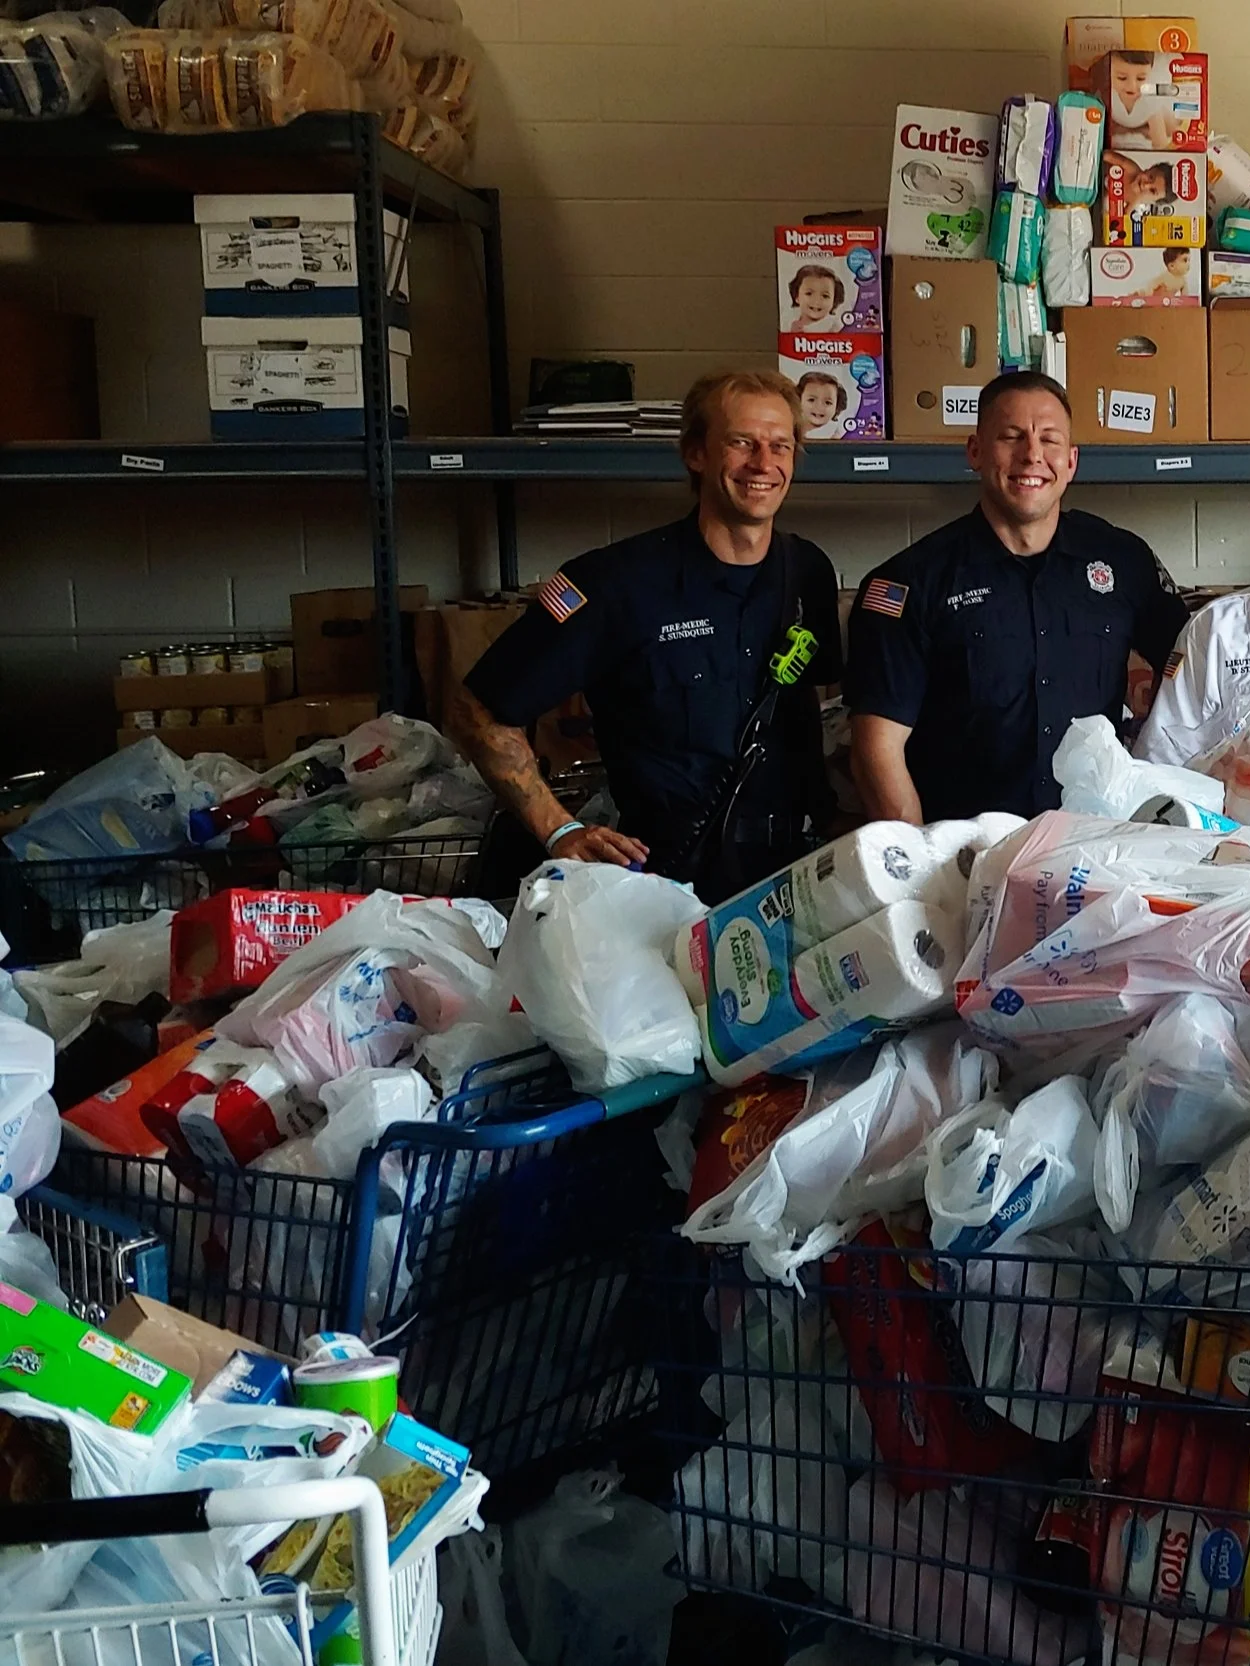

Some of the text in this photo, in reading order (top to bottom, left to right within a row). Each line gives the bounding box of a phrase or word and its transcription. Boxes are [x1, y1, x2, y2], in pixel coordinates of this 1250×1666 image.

[1169, 32, 1180, 50] 3
[900, 123, 990, 158] Cuties
[785, 230, 844, 246] HUGGIES
[794, 337, 853, 353] HUGGIES
[805, 357, 843, 365] movers
[264, 369, 300, 379] SPAGHETTI
[257, 405, 298, 413] BANKERS
[945, 399, 978, 414] SIZE
[1111, 403, 1151, 421] SIZE3
[661, 618, 710, 634] FIRE-MEDIC
[667, 626, 715, 641] SUNDQUIST
[1032, 870, 1054, 899] Pay
[740, 929, 757, 981] Strong
[729, 936, 752, 1009] Everyday
